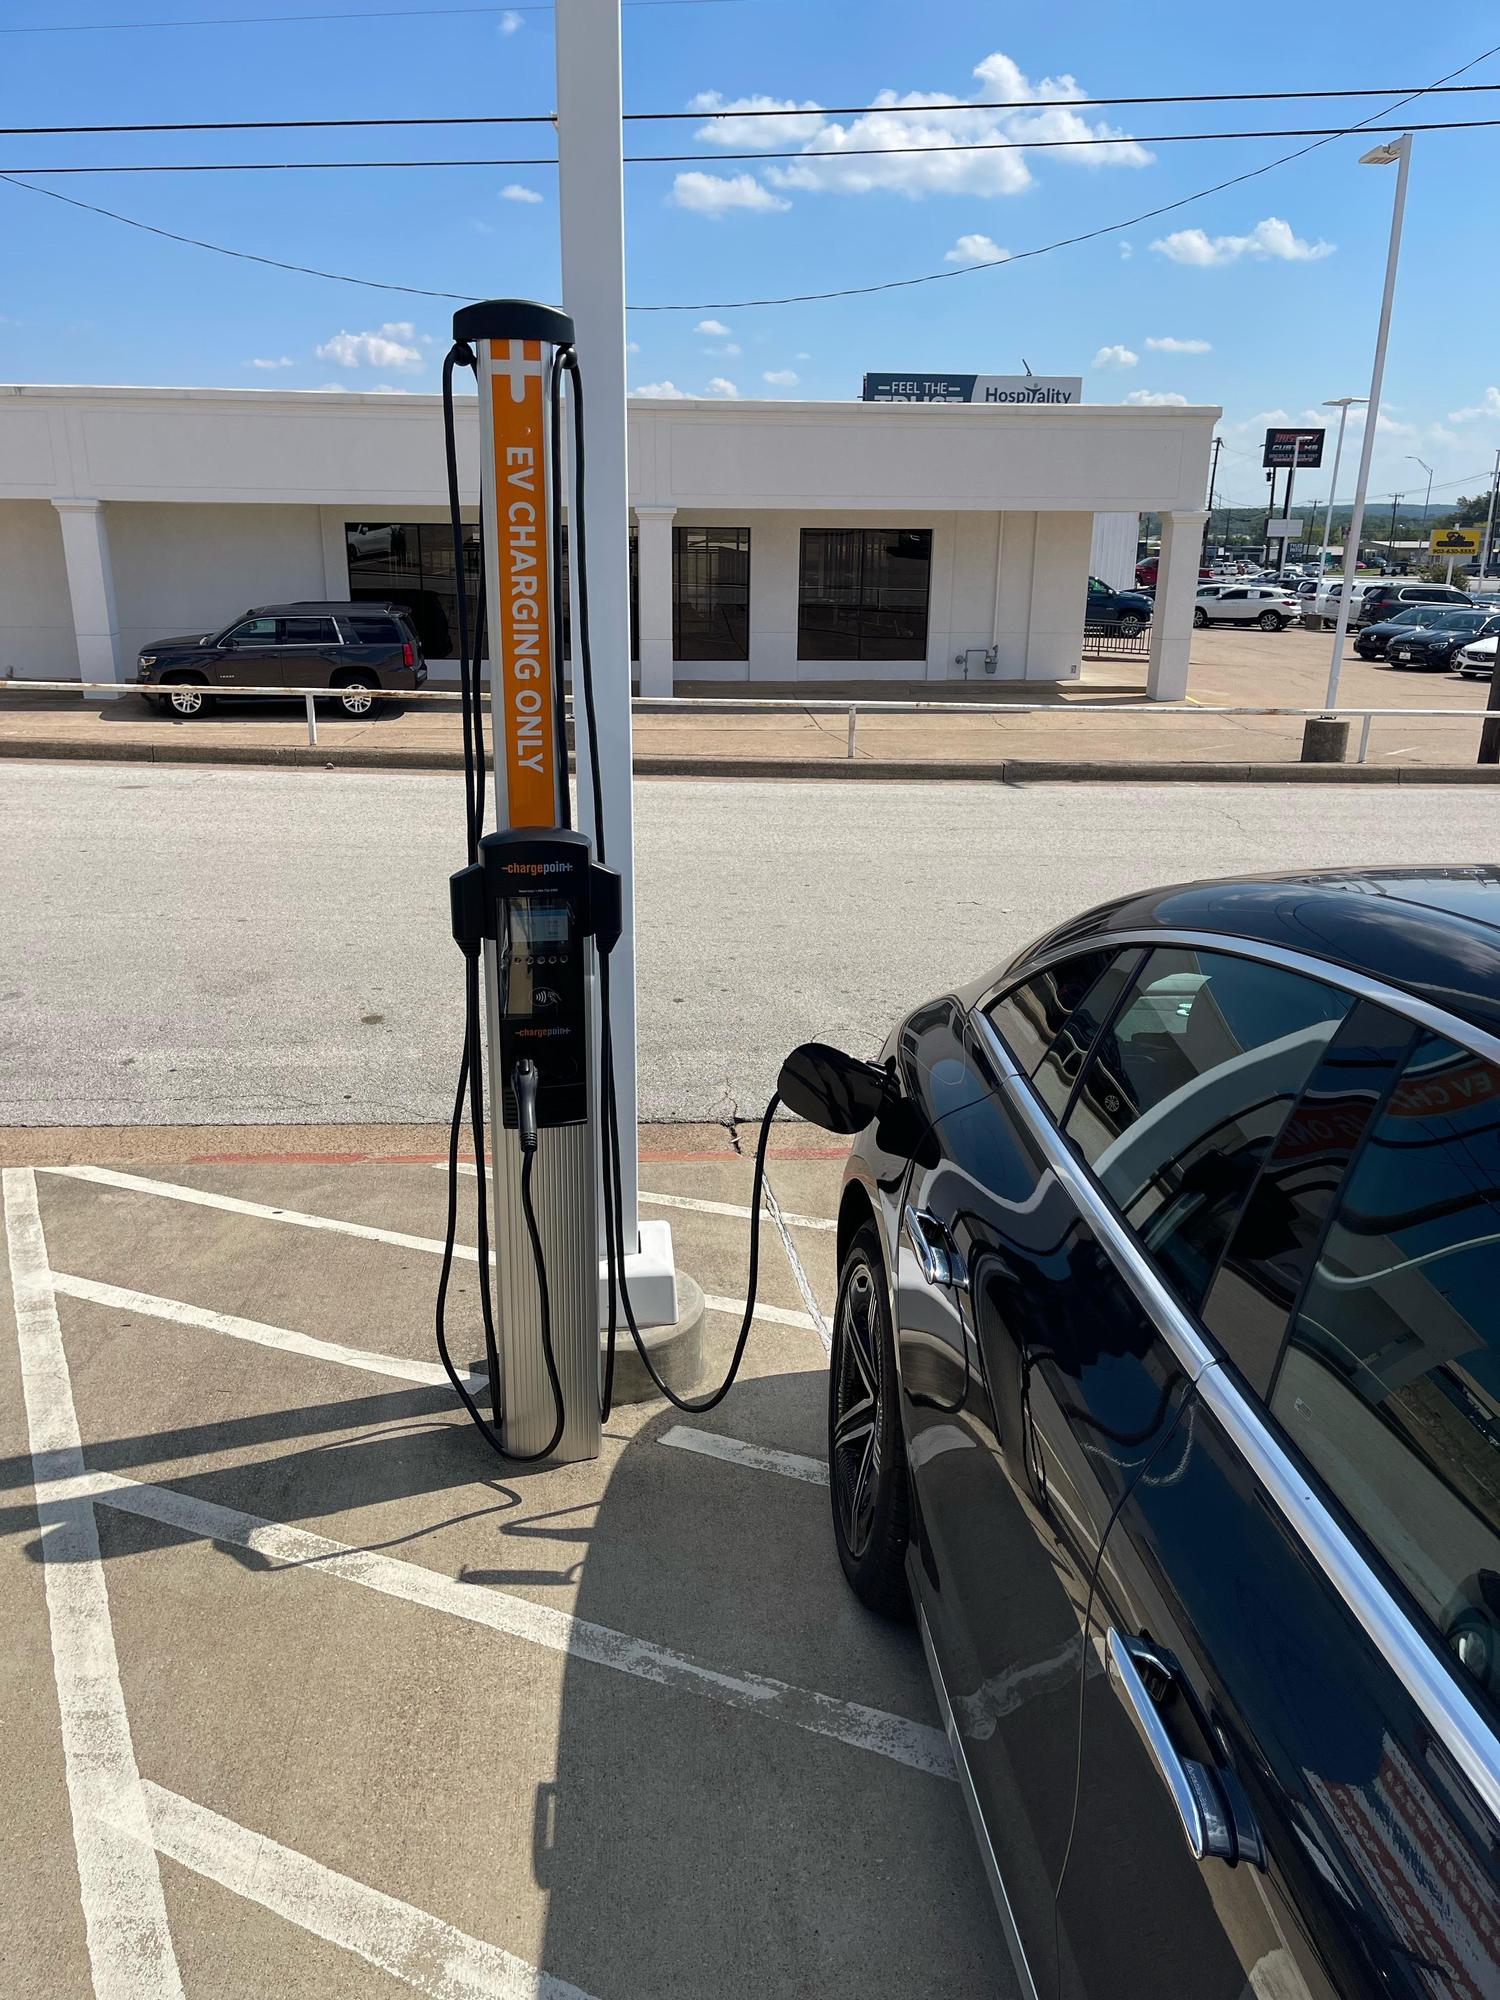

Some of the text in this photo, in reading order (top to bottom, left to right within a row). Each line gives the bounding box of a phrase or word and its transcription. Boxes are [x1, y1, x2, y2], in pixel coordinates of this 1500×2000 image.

[891, 381, 948, 395] FEEL THE
[506, 447, 544, 773] EV CHARGING ONLY
[503, 861, 573, 876] chargepoint
[516, 1027, 571, 1039] chargepoint
